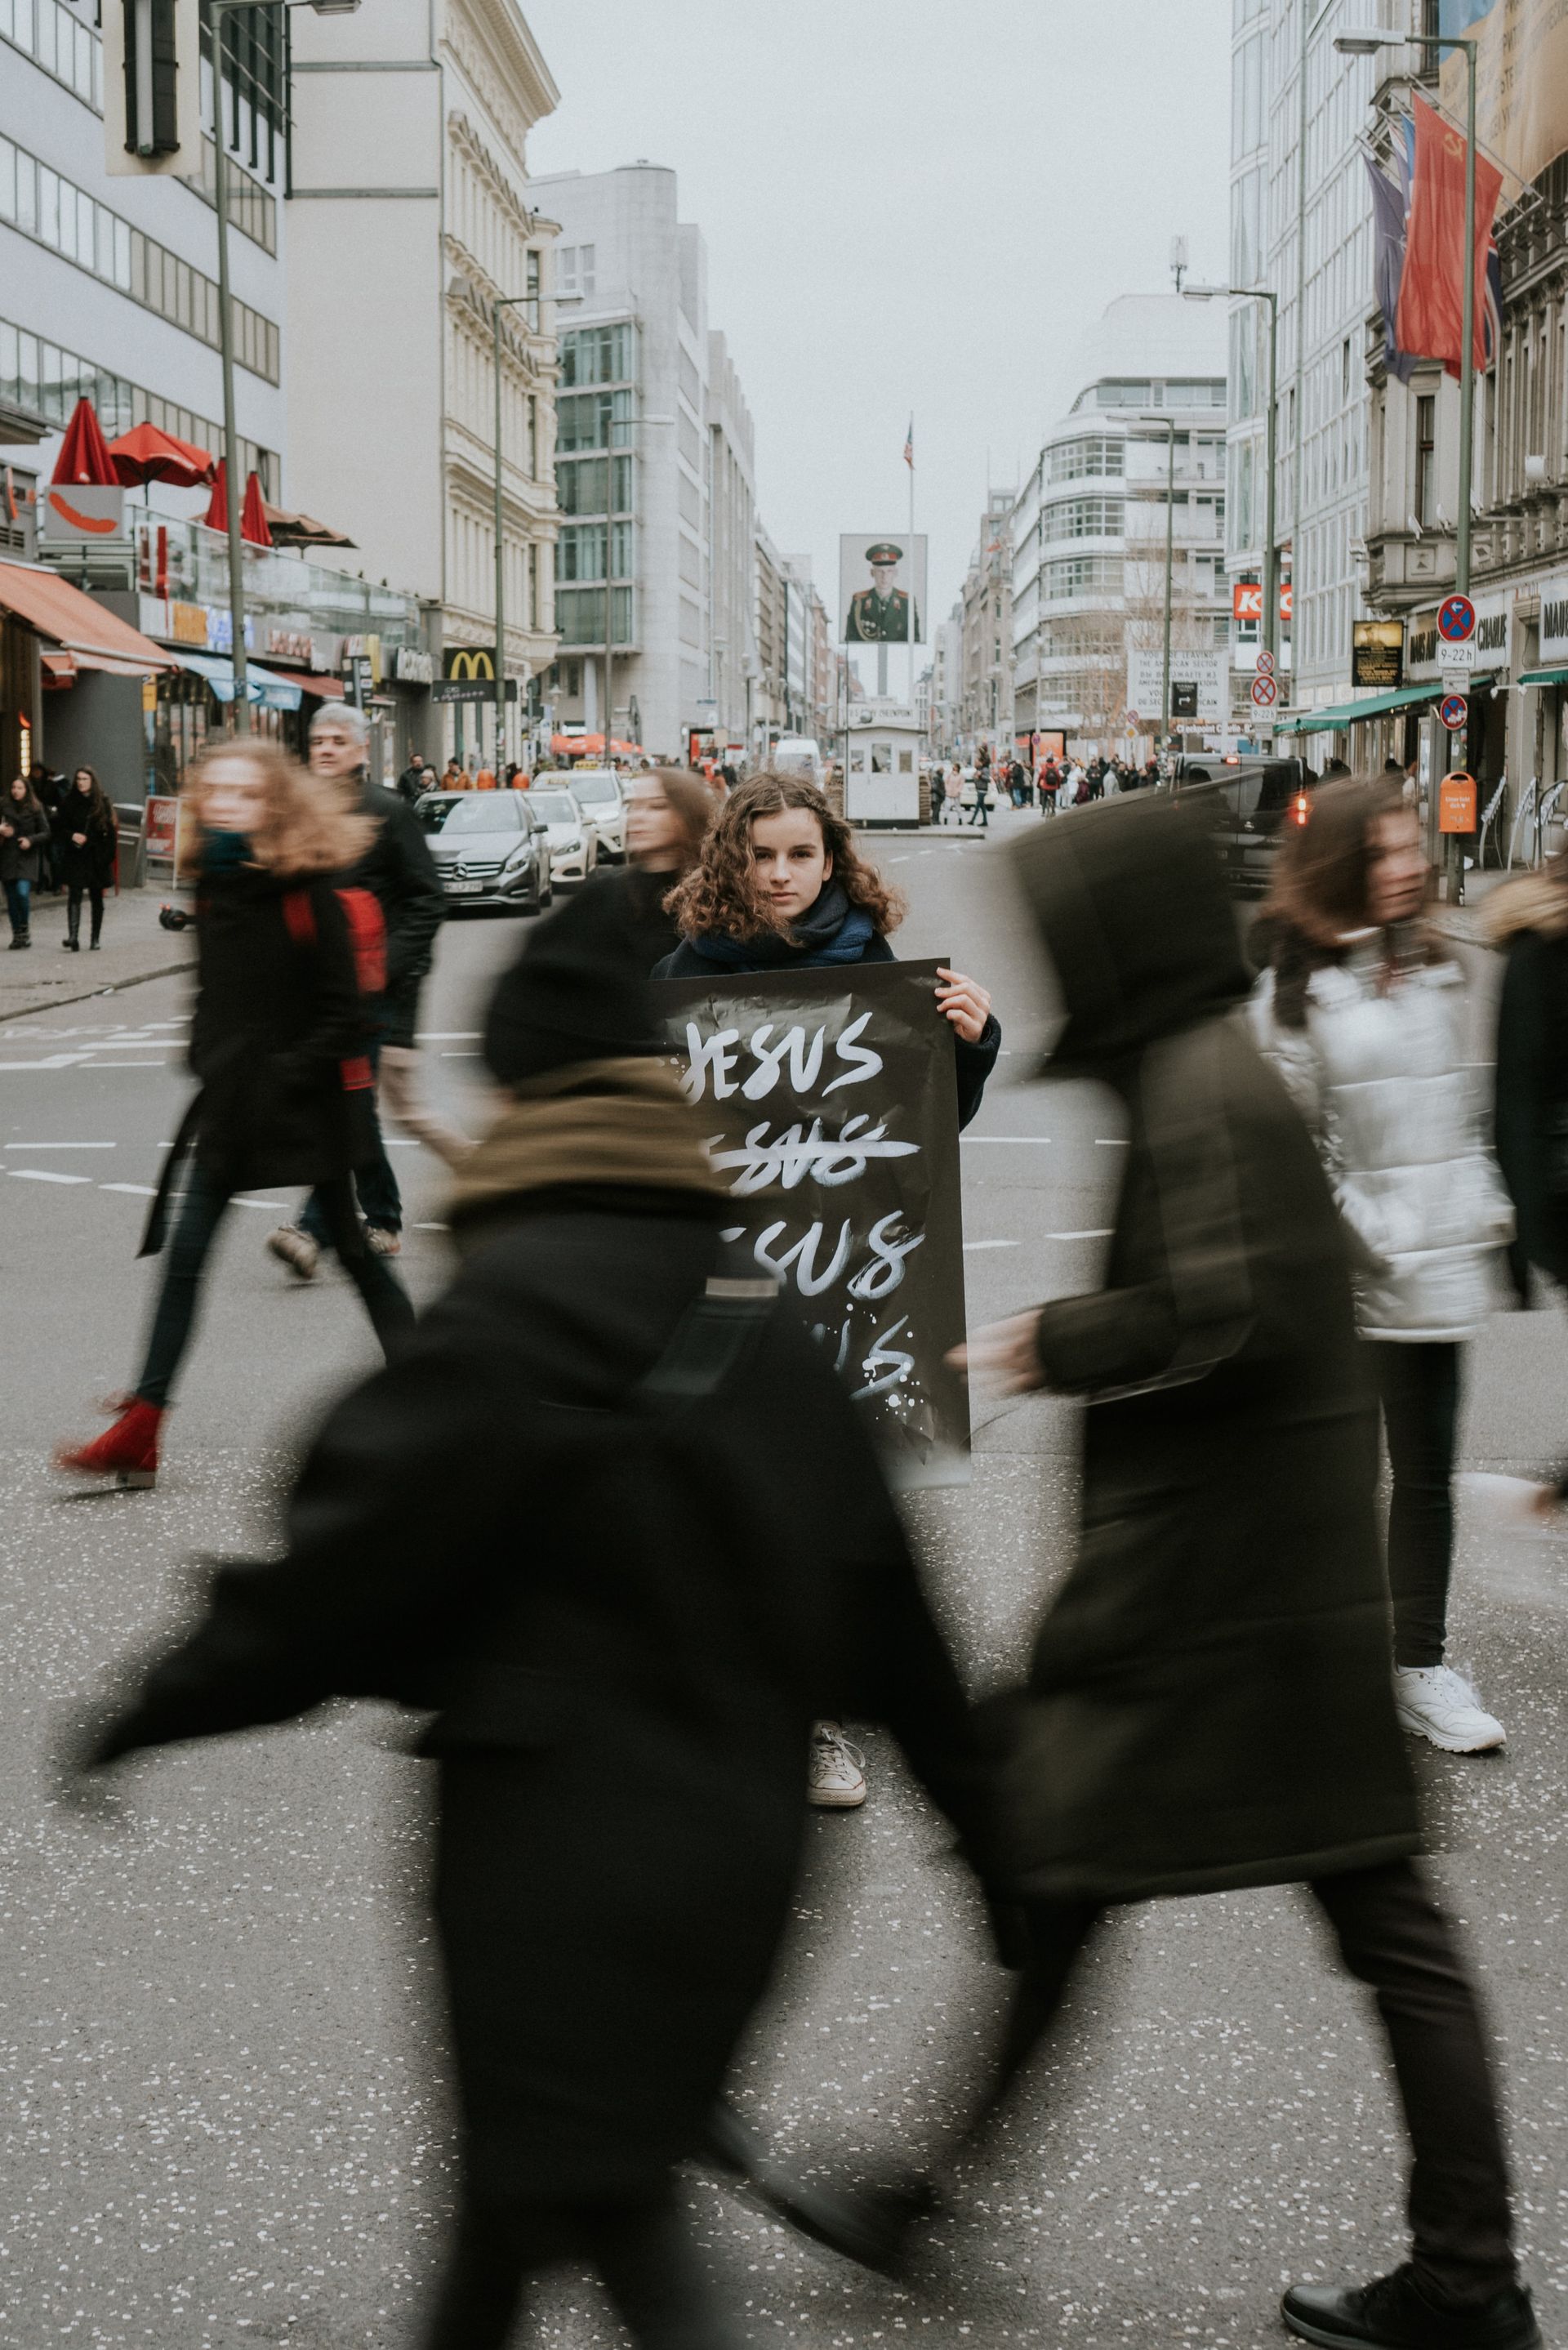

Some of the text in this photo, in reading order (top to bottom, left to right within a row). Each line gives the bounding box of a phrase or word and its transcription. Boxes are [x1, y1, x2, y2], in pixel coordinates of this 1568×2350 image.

[1237, 591, 1293, 613] KC
[1477, 613, 1507, 652] CHARLIE
[1182, 651, 1214, 659] LEAVING
[1216, 723, 1241, 734] Carlie
[677, 1011, 884, 1107] JESUS
[718, 1210, 927, 1300] SUS
